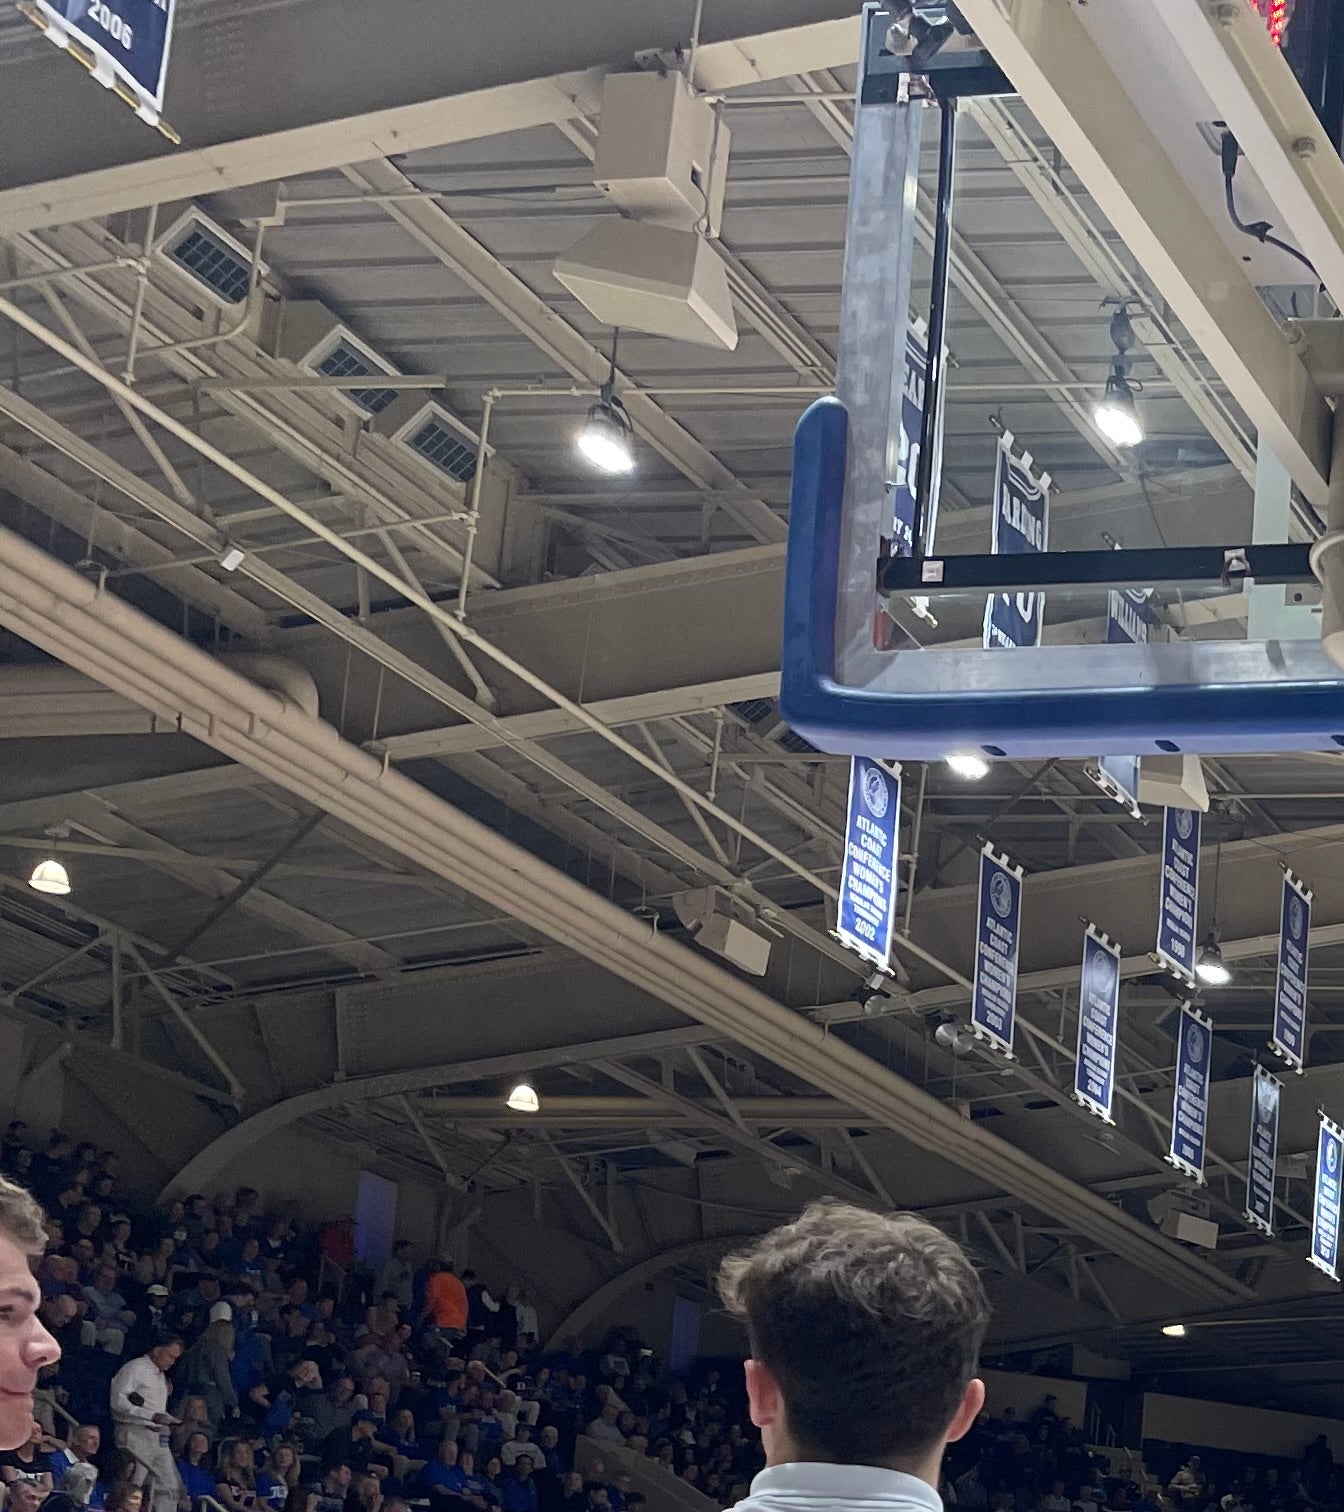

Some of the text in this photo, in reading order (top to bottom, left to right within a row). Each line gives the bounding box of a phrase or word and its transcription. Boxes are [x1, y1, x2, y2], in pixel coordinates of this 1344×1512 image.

[88, 3, 133, 50] 2006
[855, 814, 888, 847] ATLANTIC
[860, 833, 883, 859] COAST
[848, 841, 892, 883] CONFERENCE
